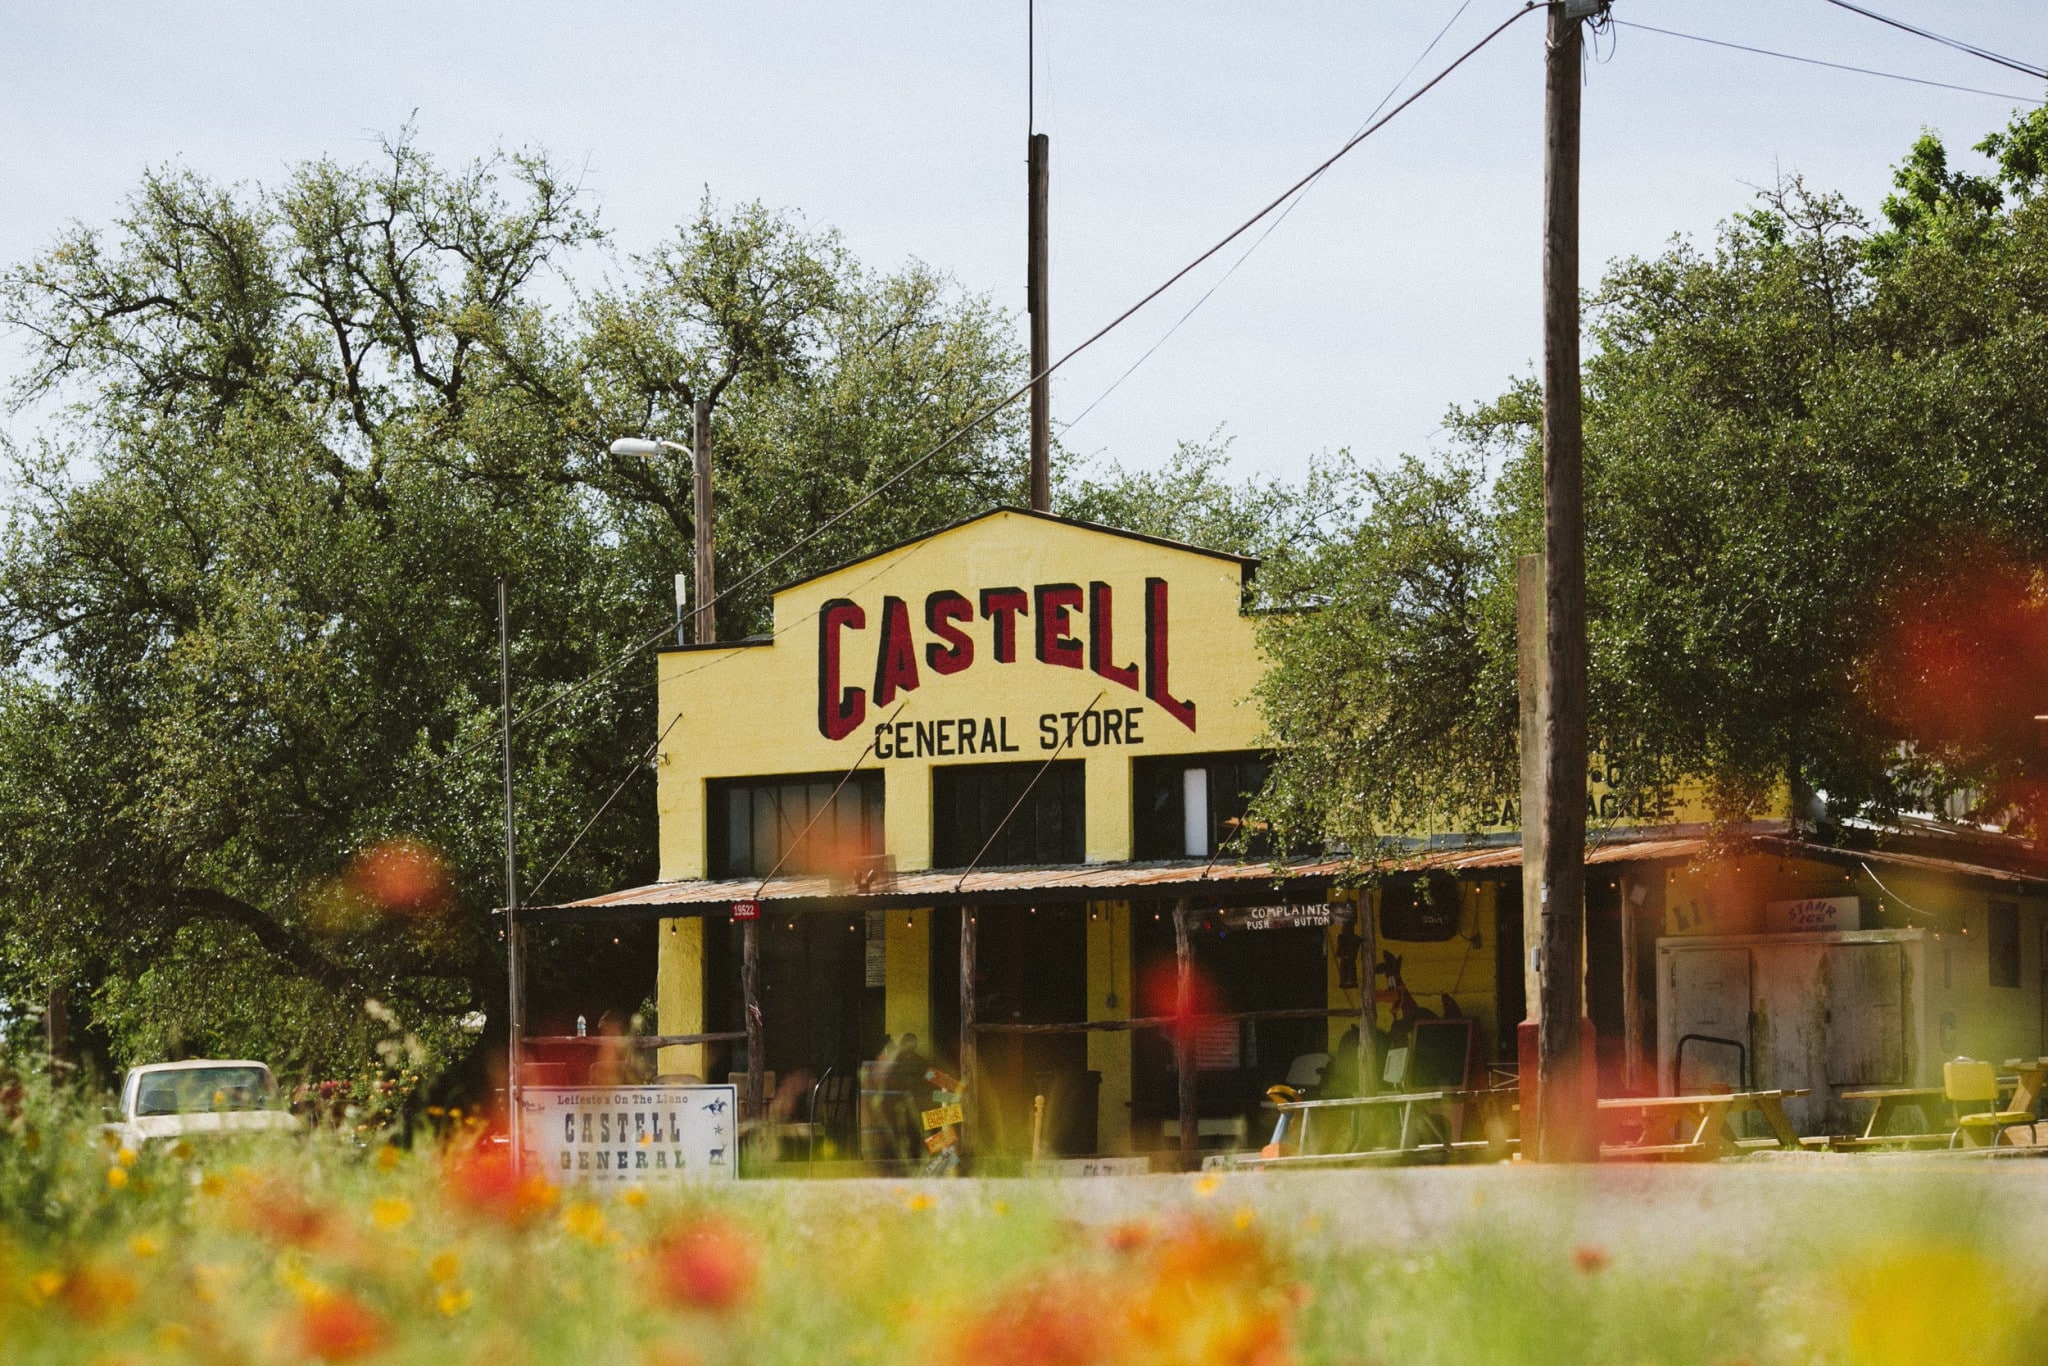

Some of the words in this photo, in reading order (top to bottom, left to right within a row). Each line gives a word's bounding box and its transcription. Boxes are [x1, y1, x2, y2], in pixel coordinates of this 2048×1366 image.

[818, 577, 1196, 740] CASTELL
[874, 716, 1019, 759] GENERAL
[1039, 707, 1144, 750] STORE
[1251, 903, 1330, 918] COMPLAINTS
[1247, 919, 1270, 930] PUSH
[1294, 916, 1330, 927] BUTTON
[614, 1095, 628, 1104] On
[632, 1095, 652, 1104] The
[656, 1094, 689, 1104] Llano
[564, 1112, 681, 1143] CASTELL
[560, 1151, 686, 1170] GENERAL
